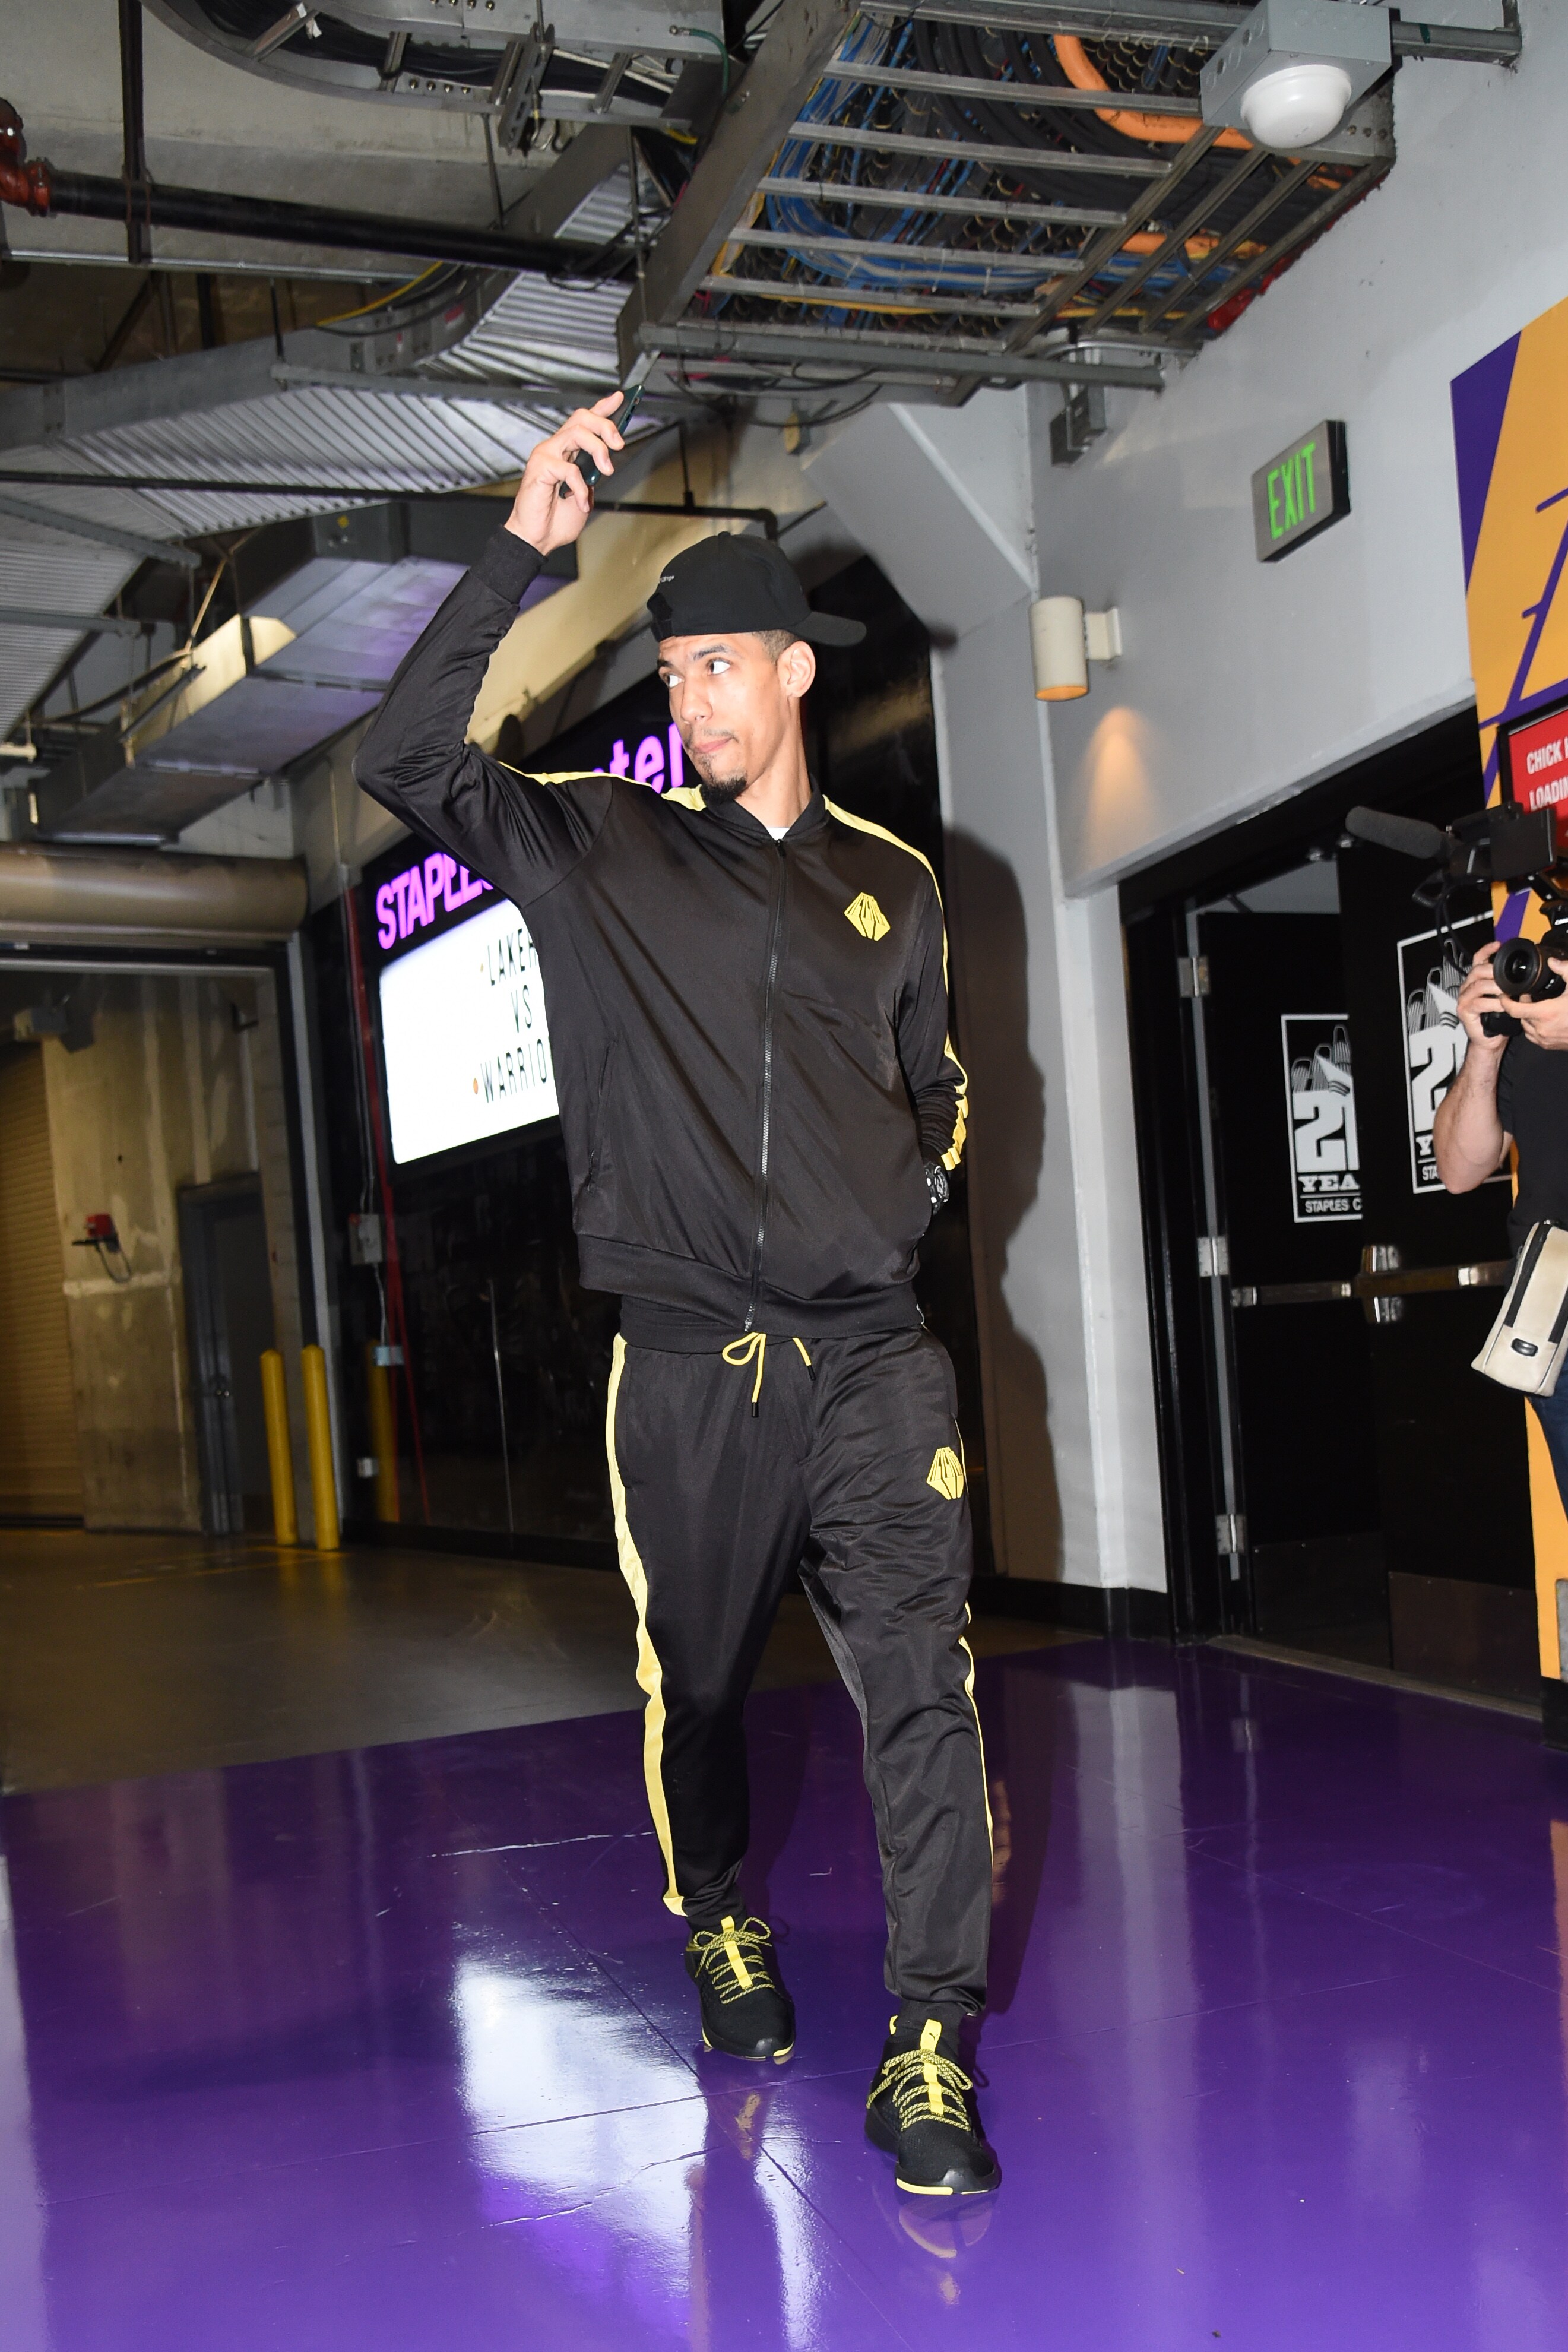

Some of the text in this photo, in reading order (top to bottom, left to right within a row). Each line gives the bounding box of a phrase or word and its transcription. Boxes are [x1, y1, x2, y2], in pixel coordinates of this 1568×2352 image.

[1267, 441, 1316, 540] EXIT
[1526, 739, 1563, 775] CHICK
[511, 985, 533, 1033] VS
[480, 1038, 547, 1103] WARRIO
[1298, 1173, 1360, 1192] YEA
[1305, 1199, 1350, 1213] STAPLES
